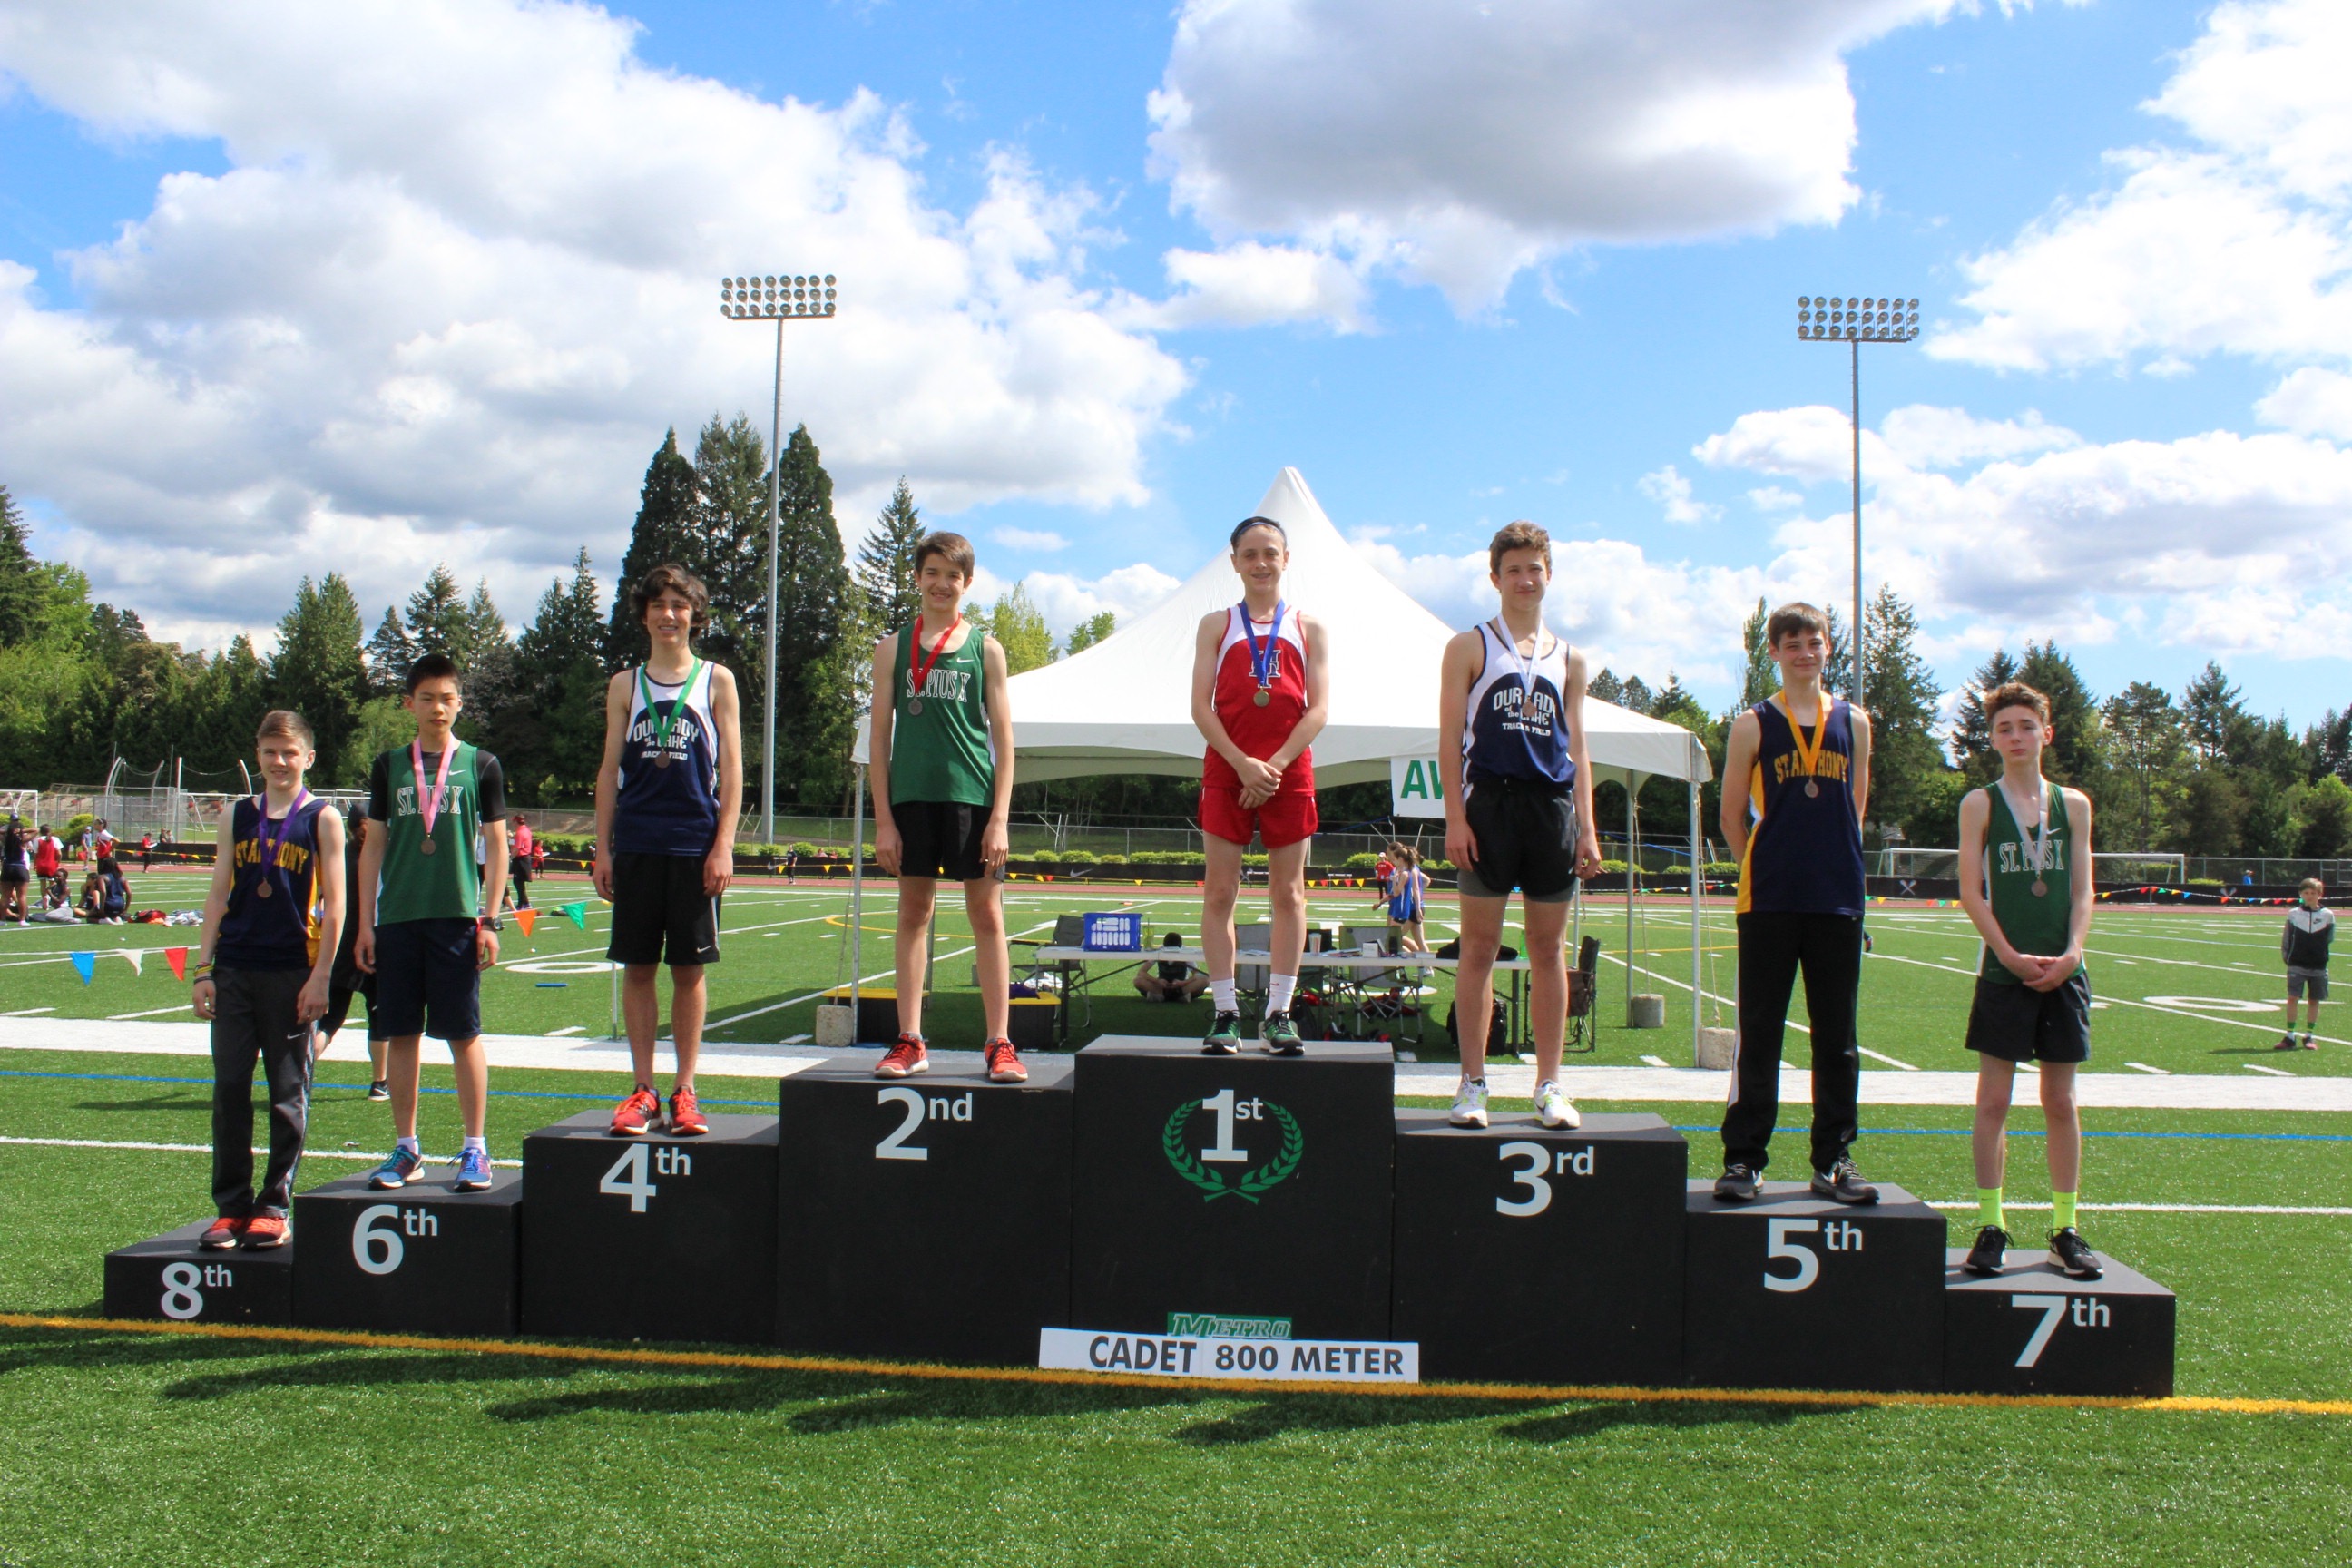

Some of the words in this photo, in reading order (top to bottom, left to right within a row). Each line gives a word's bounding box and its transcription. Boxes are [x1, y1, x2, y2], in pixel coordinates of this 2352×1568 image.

[906, 669, 925, 698] S.
[926, 669, 957, 700] PIUS
[958, 672, 971, 702] X
[1494, 687, 1522, 710] OUR
[397, 787, 416, 816] ST.
[450, 786, 464, 815] X
[1999, 842, 2021, 873] ST.
[875, 1087, 973, 1161] 2nd
[1200, 1089, 1264, 1161] 1st
[600, 1143, 691, 1213] 4th
[1495, 1142, 1594, 1217] 3rd
[352, 1204, 438, 1275] 6th
[1764, 1218, 1863, 1292] 5th
[161, 1261, 232, 1319] 8th
[1090, 1336, 1197, 1373] CADET
[1215, 1345, 1279, 1371] 800
[1291, 1346, 1404, 1375] METER
[2012, 1294, 2111, 1367] 7th
